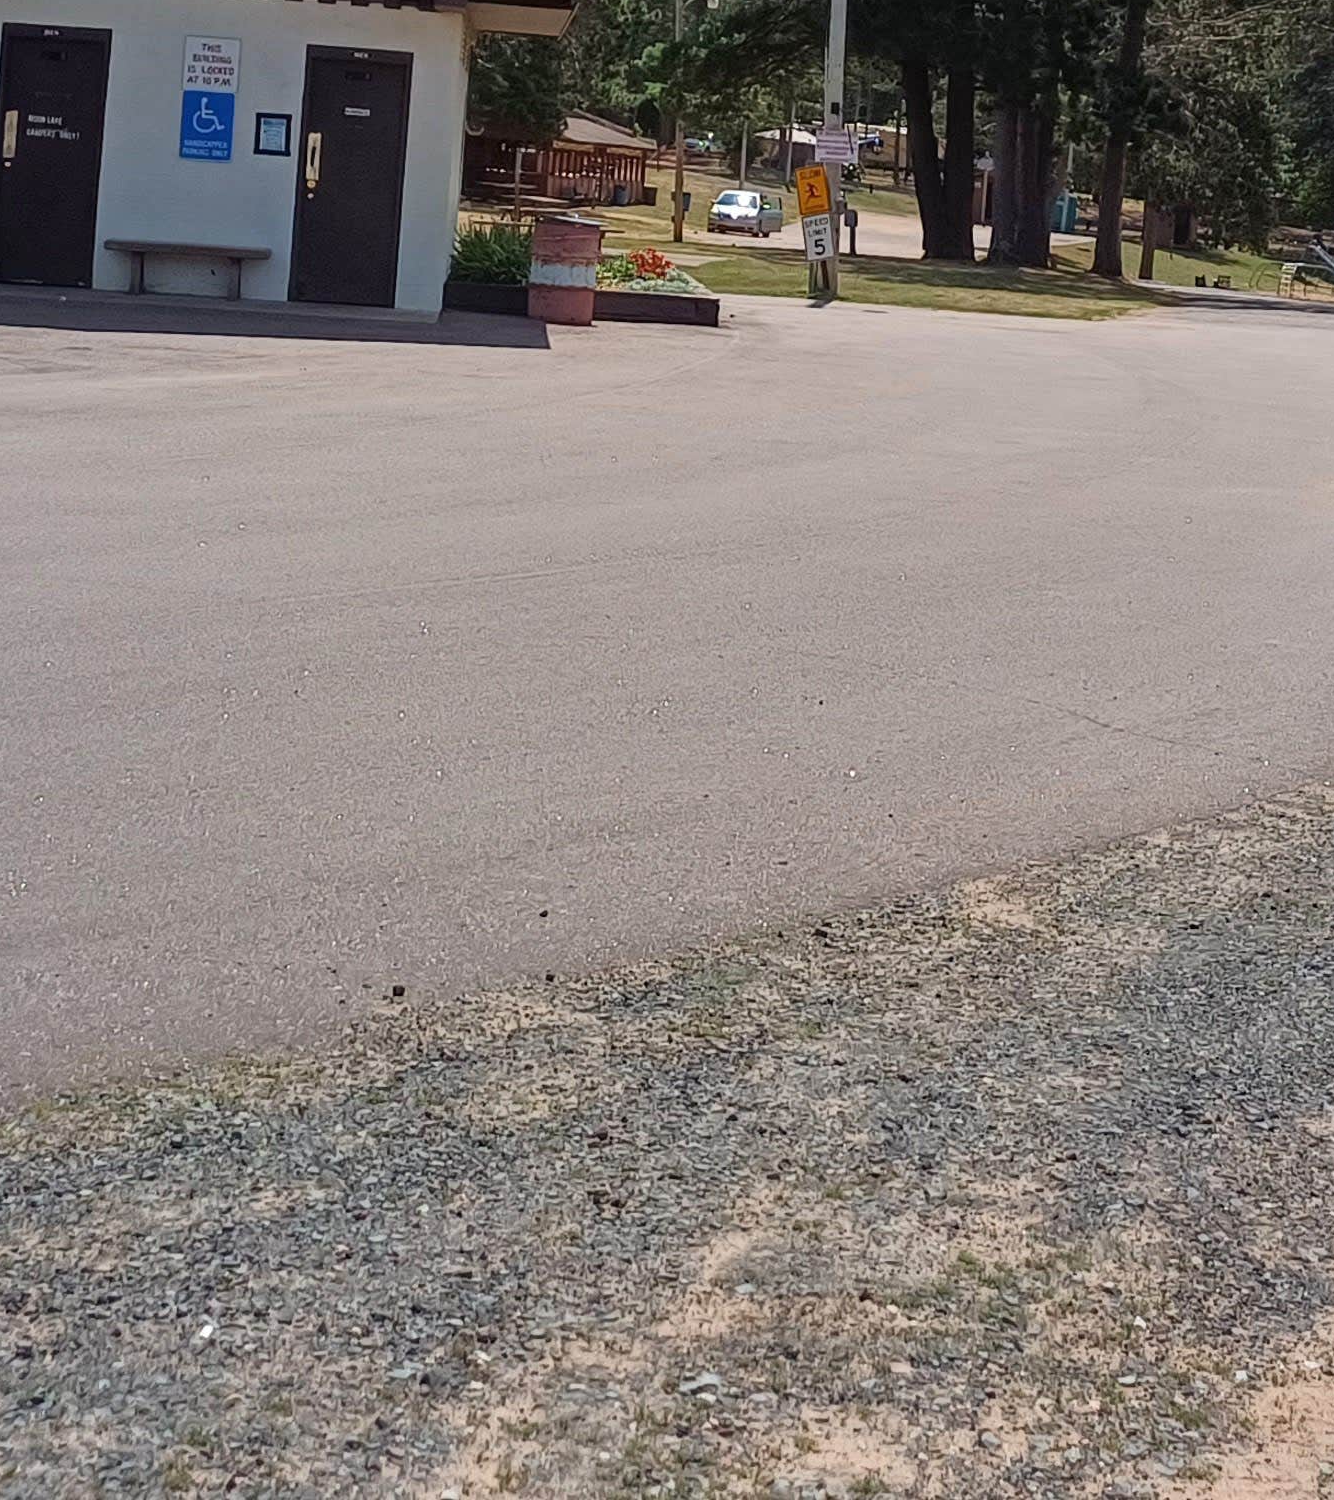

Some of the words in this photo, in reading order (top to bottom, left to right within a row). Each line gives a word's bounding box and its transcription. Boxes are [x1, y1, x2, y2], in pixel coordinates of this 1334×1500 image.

[201, 43, 222, 53] THIS
[192, 54, 232, 64] BUILDING
[187, 65, 196, 74] IS
[201, 66, 235, 76] LOCKED
[186, 75, 199, 84] AT
[203, 76, 212, 85] 10
[799, 169, 822, 180] SLOW
[804, 217, 828, 228] SPEED
[808, 227, 827, 238] LIMIT
[814, 238, 826, 256] 5
